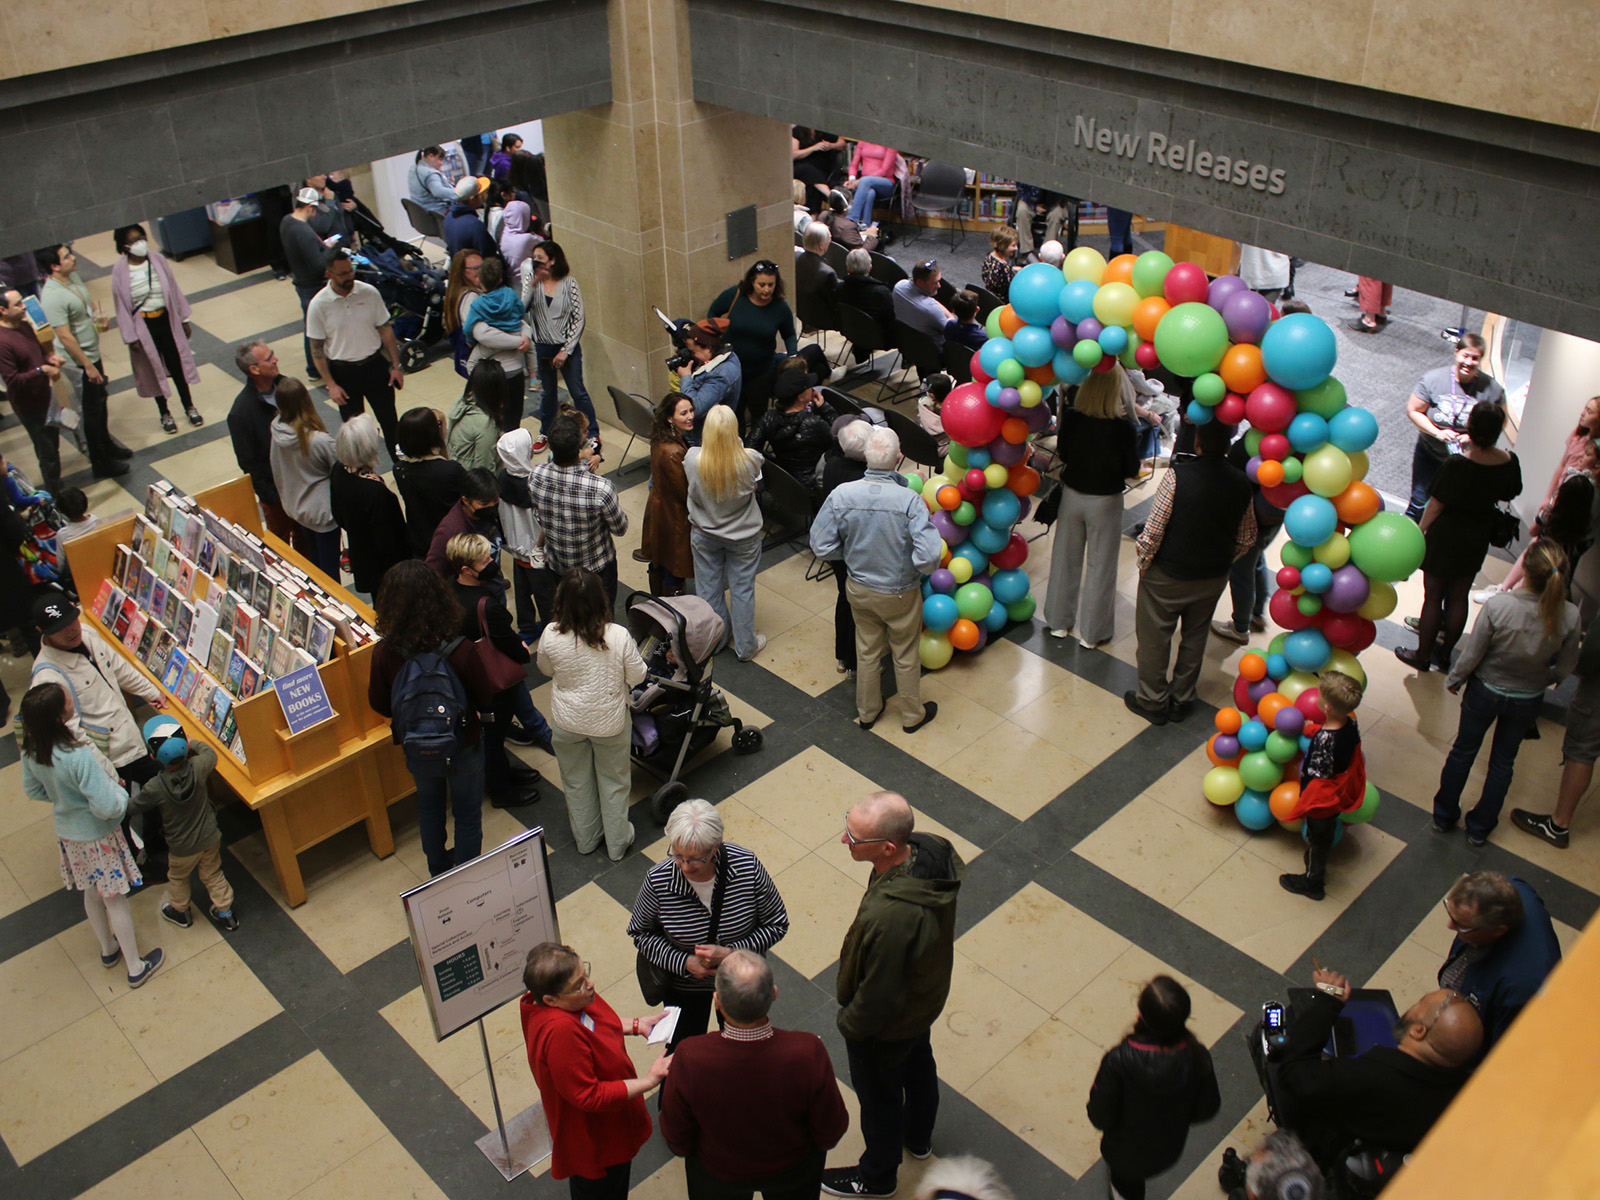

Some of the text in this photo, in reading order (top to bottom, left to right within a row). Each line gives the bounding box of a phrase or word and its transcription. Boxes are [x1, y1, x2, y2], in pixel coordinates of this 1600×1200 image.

[1074, 115, 1287, 195] New Releases
[282, 673, 313, 690] find more
[289, 683, 311, 699] NEW
[288, 692, 322, 714] BOOKS
[466, 890, 492, 904] Computers
[432, 930, 467, 950] Special Collections
[446, 952, 466, 965] HOURS
